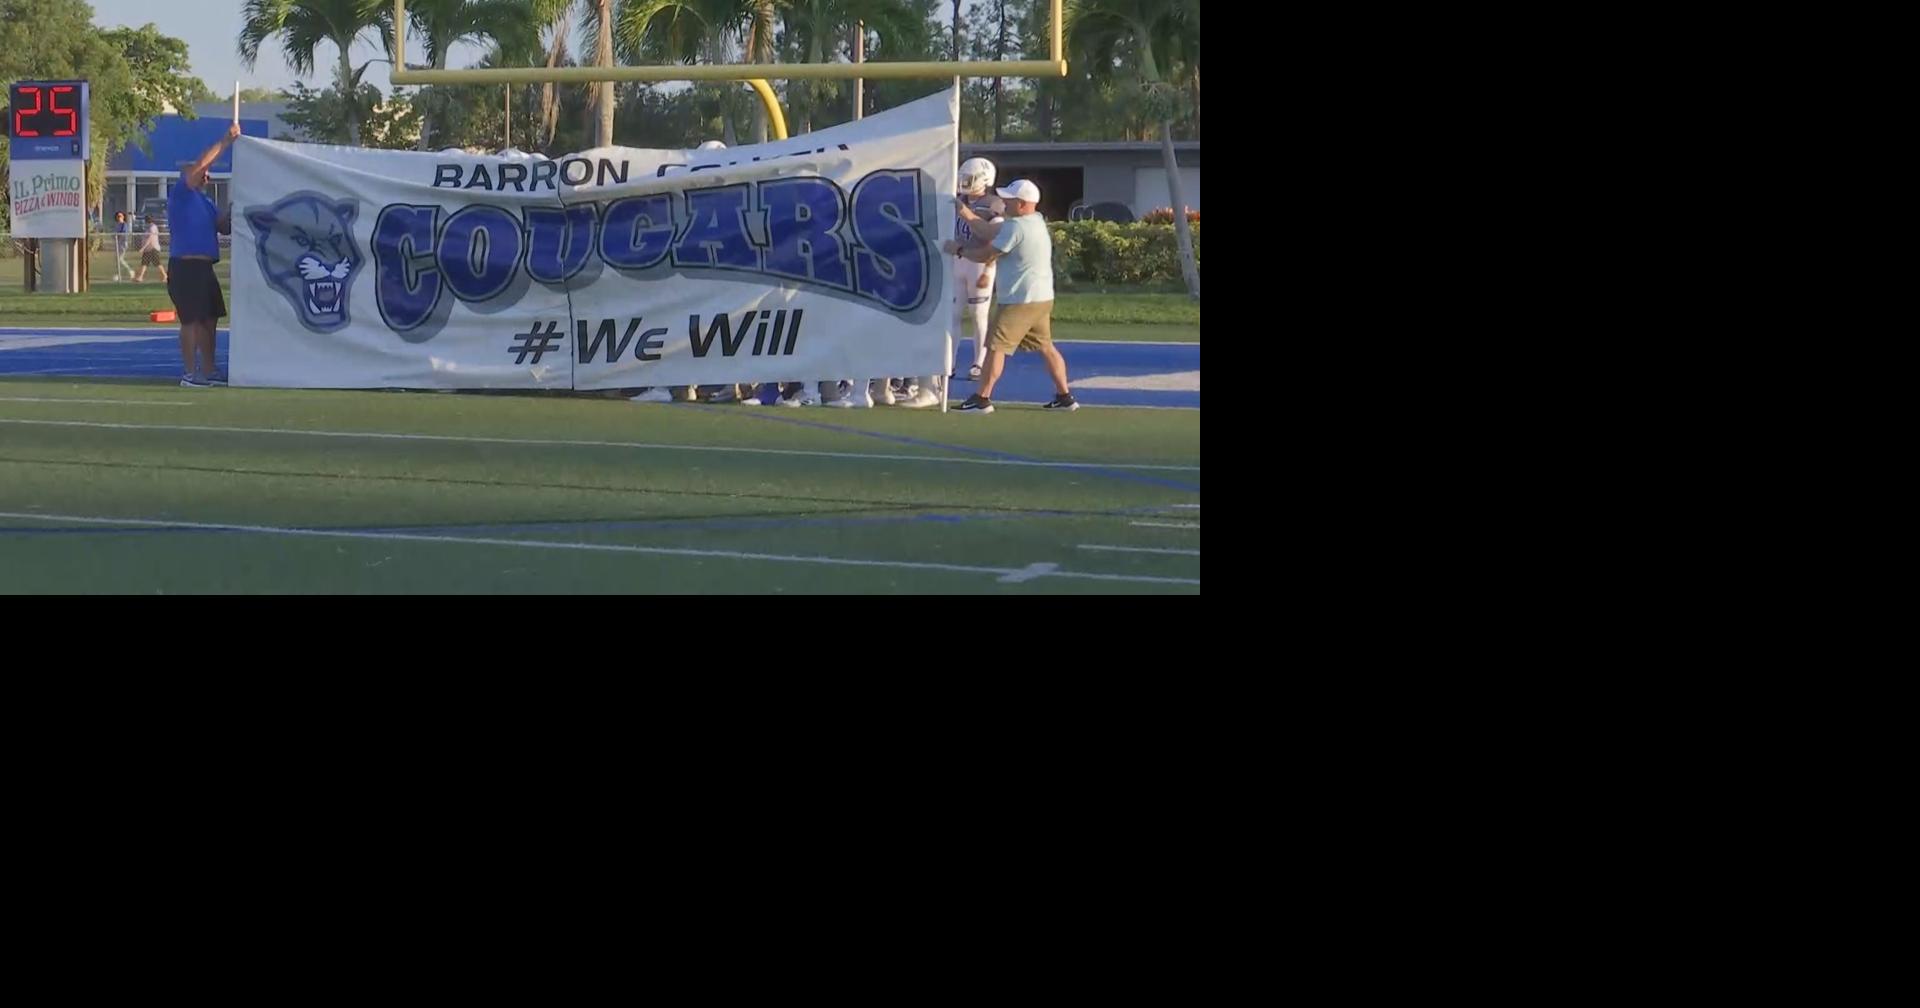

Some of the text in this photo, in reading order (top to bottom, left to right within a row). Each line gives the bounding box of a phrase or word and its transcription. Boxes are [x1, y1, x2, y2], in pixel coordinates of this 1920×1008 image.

[15, 86, 77, 137] 25
[32, 173, 81, 196] Primo
[432, 157, 629, 192] BARRON
[14, 196, 41, 217] PIZZA
[370, 167, 935, 335] COUGARS
[688, 308, 804, 358] Will
